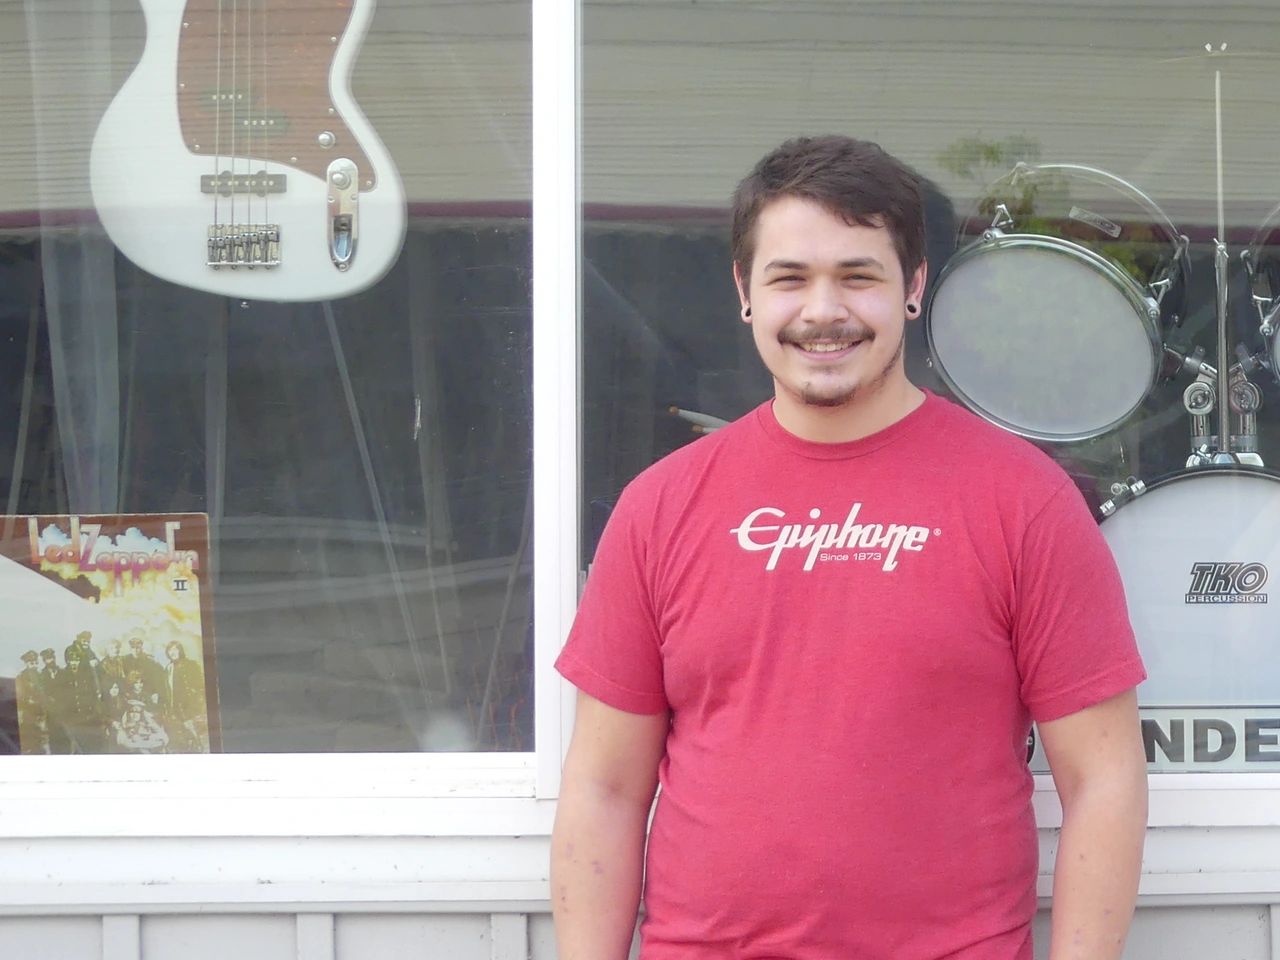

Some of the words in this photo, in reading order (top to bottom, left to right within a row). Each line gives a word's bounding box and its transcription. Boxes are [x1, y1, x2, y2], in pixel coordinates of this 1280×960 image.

[28, 516, 80, 565] Led
[729, 502, 930, 572] Epiphone
[820, 552, 849, 562] Since
[853, 552, 882, 561] 1873
[1188, 561, 1269, 593] TKO
[1186, 594, 1267, 603] PERCUSSION
